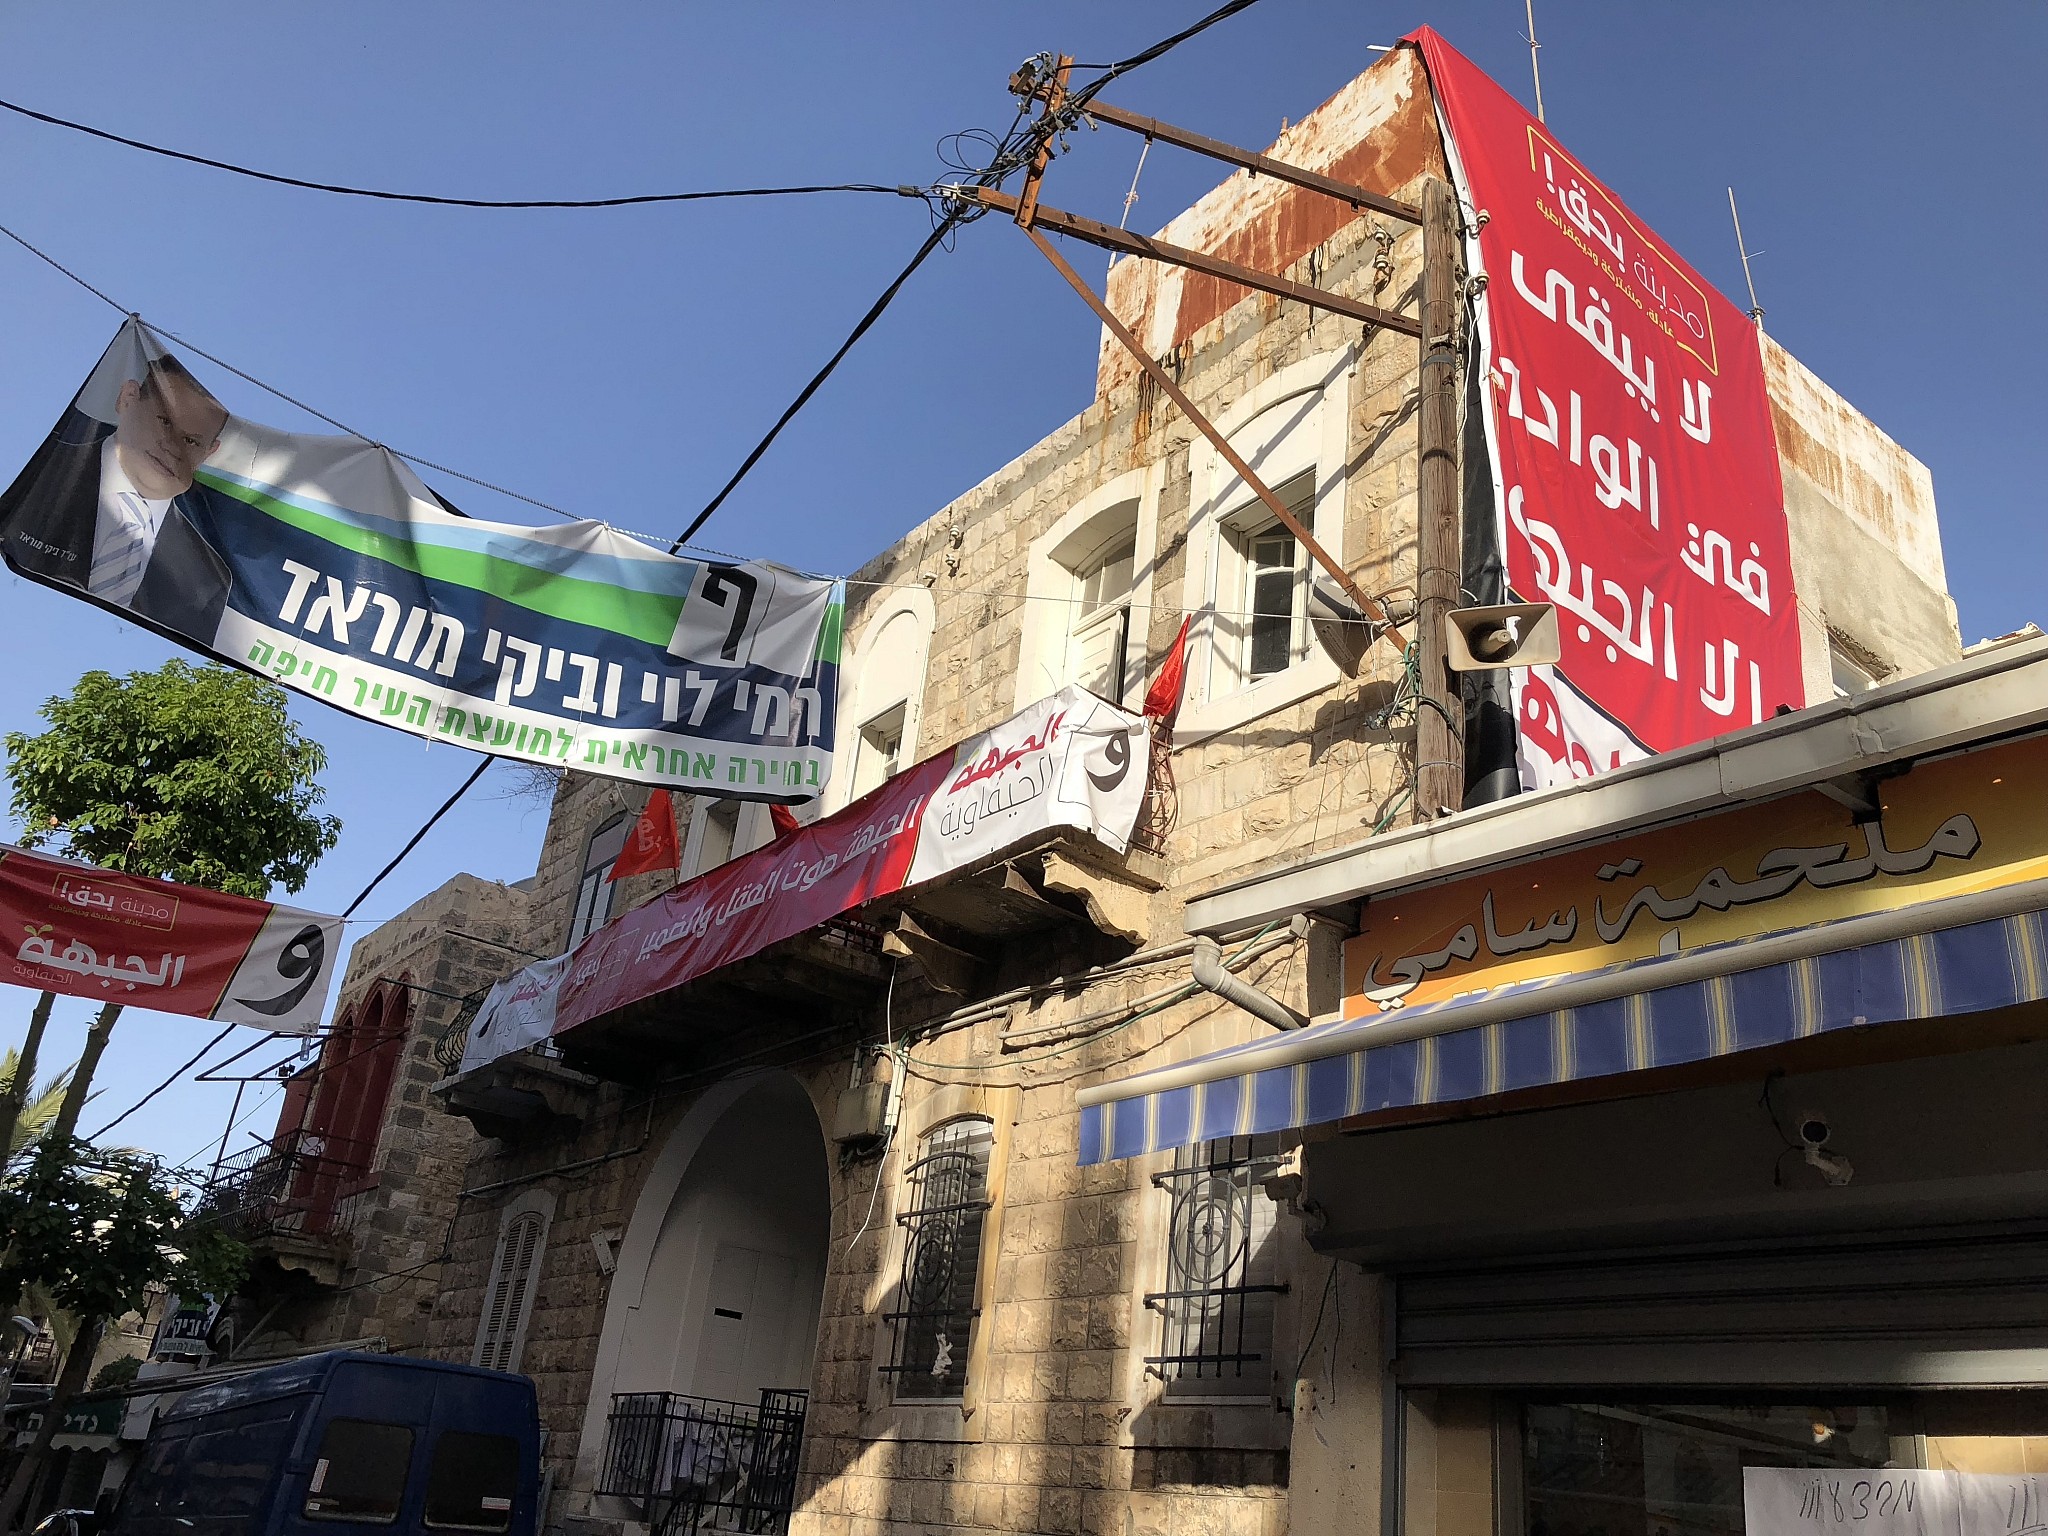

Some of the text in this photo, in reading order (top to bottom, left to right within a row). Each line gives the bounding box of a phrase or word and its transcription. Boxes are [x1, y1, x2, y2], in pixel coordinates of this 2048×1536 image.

[1543, 151, 1705, 339] مدينة بحق!
[1679, 376, 1712, 445] لا
[19, 530, 43, 550] מוראד
[277, 558, 822, 738] רמי לוי וביקי מוראד
[247, 638, 820, 787] בחירה אחראית למועצת העיר חיפה
[841, 793, 925, 864] الجبهة
[939, 753, 1054, 841] الحيفاوية
[60, 881, 169, 920] مدينة بحق!
[716, 867, 779, 925] العقل
[781, 853, 838, 892] صوت
[1594, 813, 1982, 944] ملحمة
[16, 924, 186, 993] الجبهة
[1362, 887, 1578, 1012] سامي
